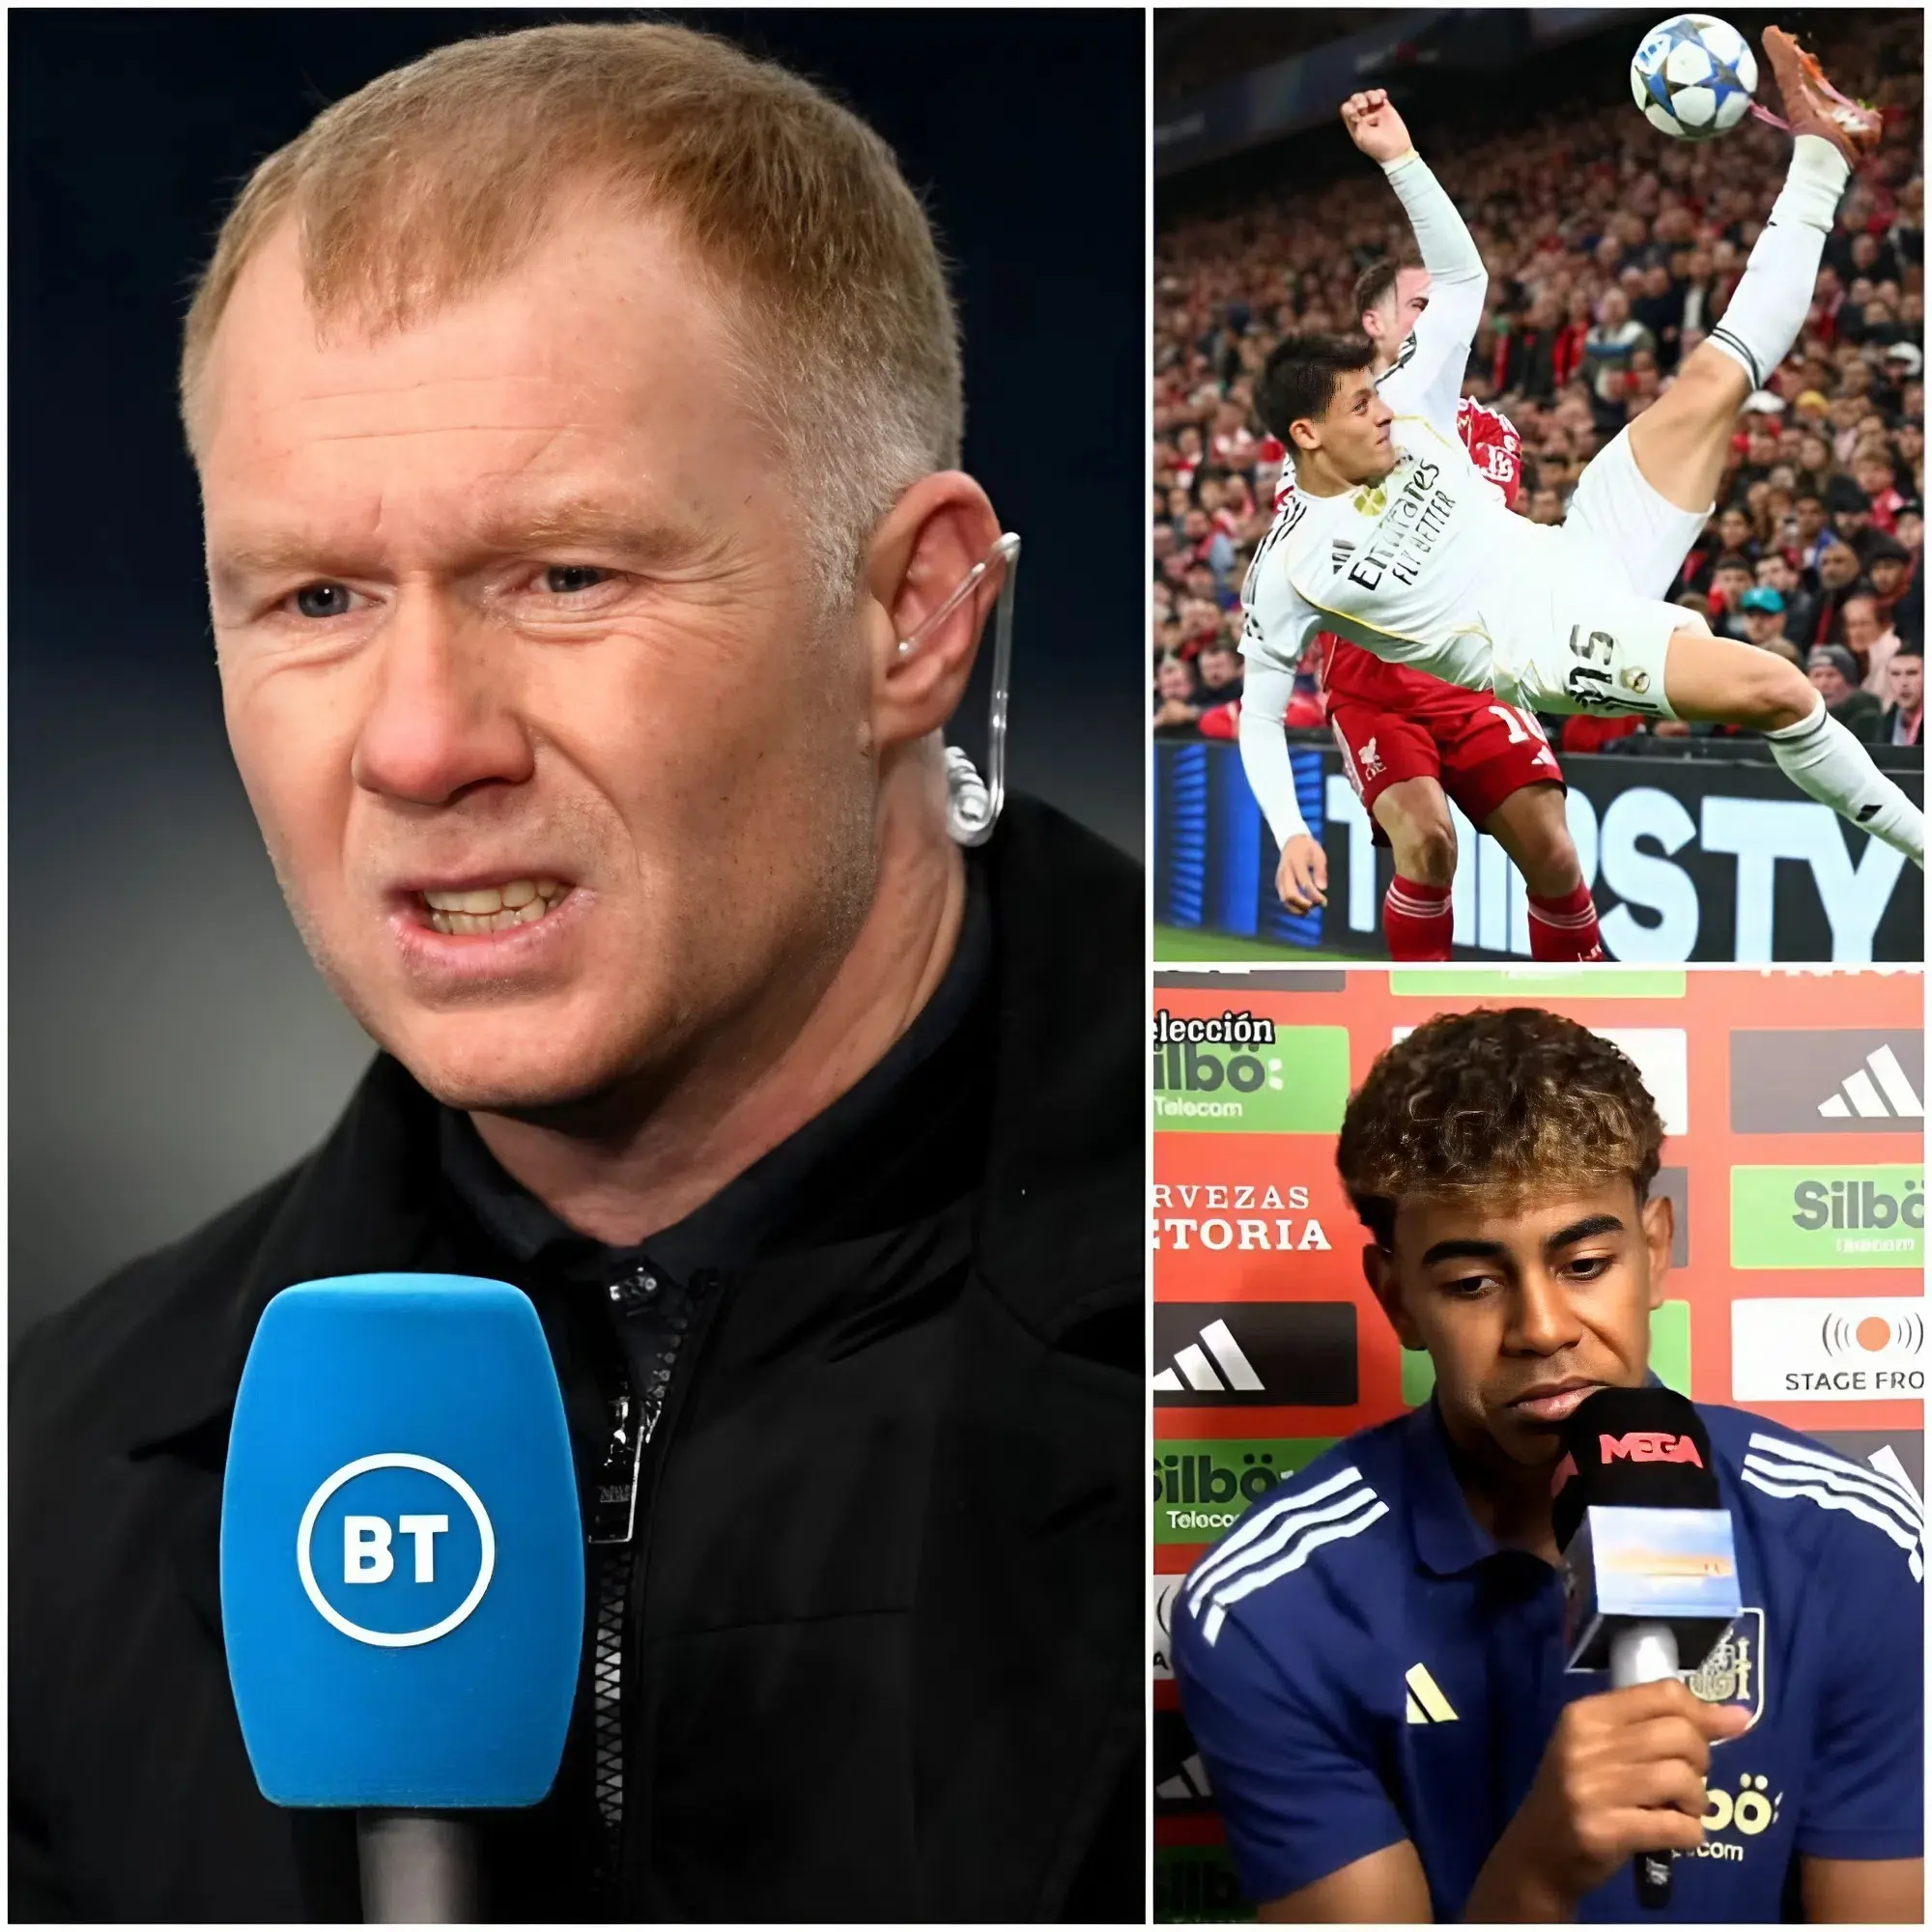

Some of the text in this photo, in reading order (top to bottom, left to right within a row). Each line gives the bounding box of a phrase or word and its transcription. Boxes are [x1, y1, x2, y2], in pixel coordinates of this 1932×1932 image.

[1785, 1372, 1866, 1391] STAGE
[1599, 1432, 1704, 1468] MEGA
[1166, 1510, 1240, 1529] Teleco
[344, 1514, 449, 1584] BT
